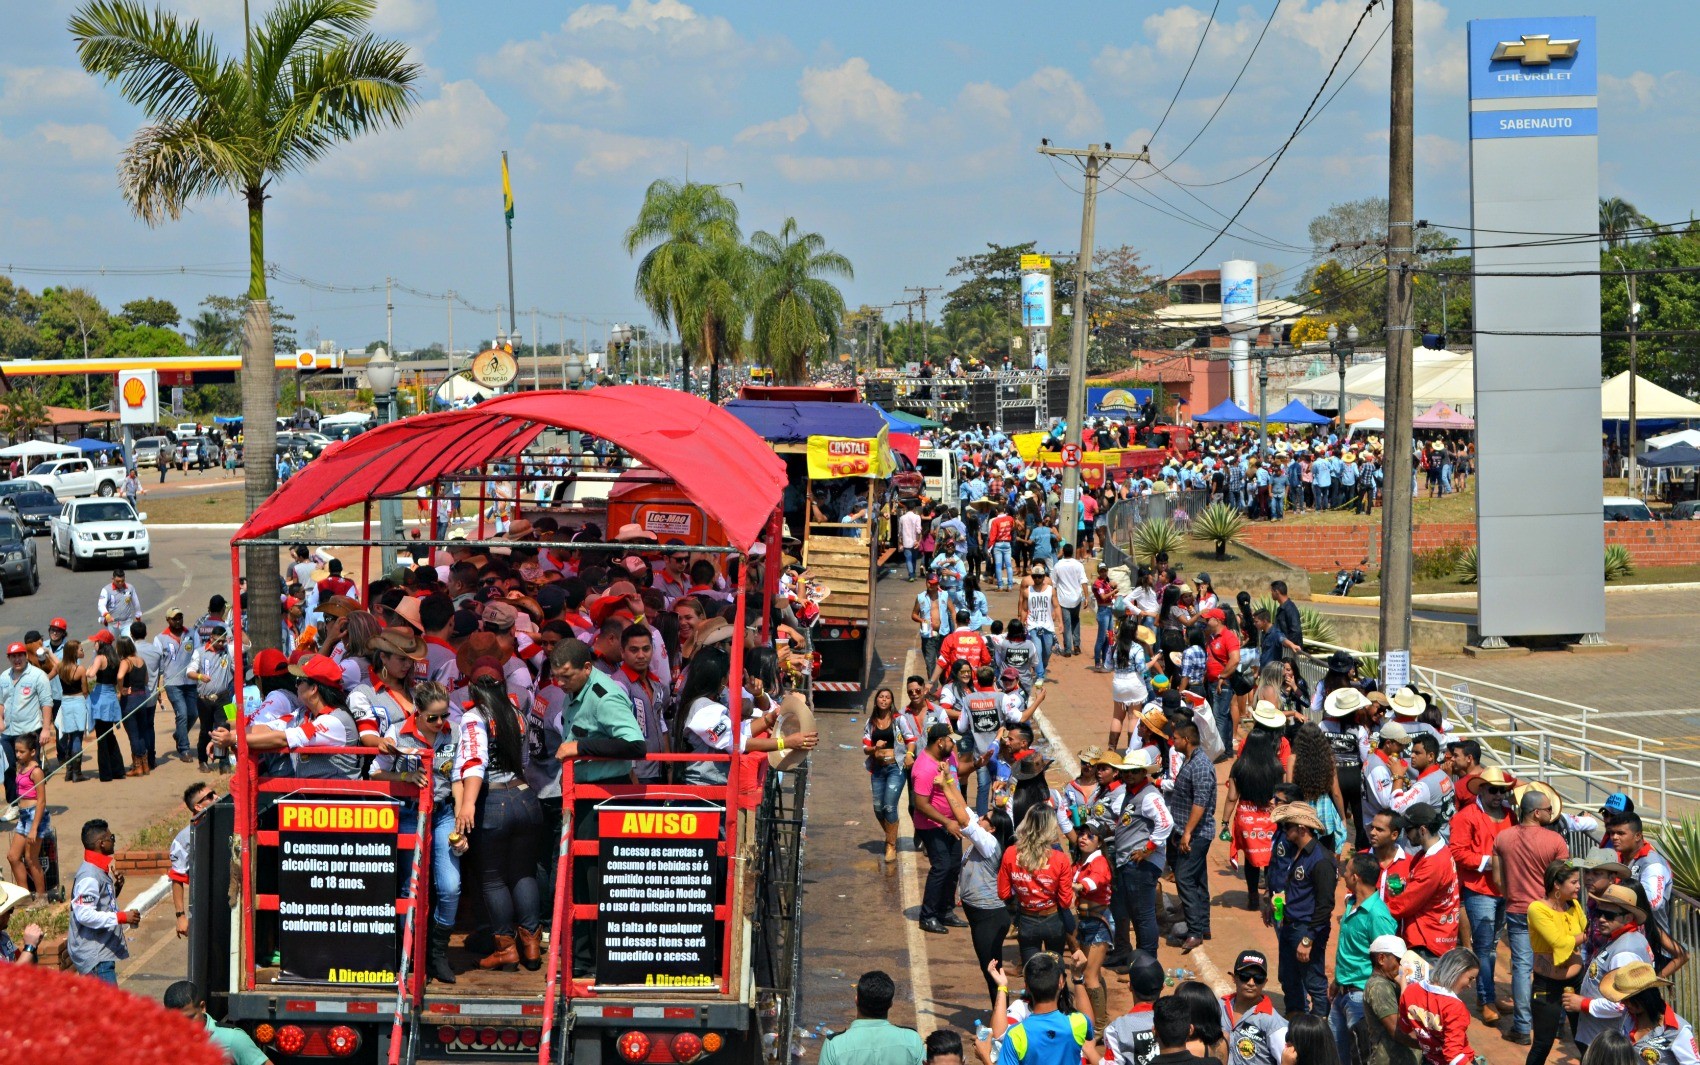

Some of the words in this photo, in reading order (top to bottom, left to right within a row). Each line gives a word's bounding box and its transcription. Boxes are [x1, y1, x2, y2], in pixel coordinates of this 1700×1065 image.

[1497, 72, 1573, 82] CHEVROLET
[1500, 117, 1573, 130] SABENAUTO
[829, 441, 867, 455] CRYSTAL
[1031, 596, 1049, 609] OMG
[283, 807, 394, 829] PROIBIDO
[622, 813, 697, 834] AVISO
[284, 842, 290, 853] O
[293, 844, 338, 855] consumo
[341, 843, 353, 855] de
[356, 843, 391, 856] bebida
[613, 847, 618, 857] O
[620, 848, 649, 857] acesso
[651, 849, 661, 857] as
[663, 848, 696, 857] carretas
[698, 849, 703, 857] e
[282, 859, 328, 871] alcoólica
[331, 862, 347, 873] por
[350, 862, 394, 873] menores
[607, 862, 645, 870] consumo
[646, 860, 656, 871] de
[658, 860, 690, 871] bebidas
[692, 860, 702, 871] só
[703, 860, 708, 871] é
[311, 876, 323, 888] de
[325, 877, 336, 888] 18
[338, 878, 365, 889] anos.
[603, 874, 643, 885] permitido
[645, 876, 662, 885] com
[664, 876, 669, 885] a
[670, 875, 699, 885] camisa
[701, 875, 711, 885] da
[610, 888, 645, 898] comitiva
[647, 888, 674, 901] Galpão
[676, 888, 706, 899] Modelo
[280, 902, 303, 915] Sobe
[306, 905, 329, 918] pena
[331, 904, 343, 916] de
[345, 904, 395, 918] apreensão
[600, 903, 605, 912] e
[606, 904, 611, 912] o
[613, 904, 628, 912] uso
[630, 902, 640, 912] da
[641, 902, 674, 913] pulseira
[676, 904, 686, 912] no
[688, 902, 713, 914] braço.
[283, 919, 328, 932] conforme
[330, 922, 336, 932] a
[338, 920, 351, 932] Lei
[353, 923, 368, 933] em
[369, 921, 395, 935] vigor.
[608, 922, 620, 933] Na
[621, 922, 643, 933] falta
[645, 923, 658, 933] de
[659, 923, 703, 935] qualquer
[606, 938, 621, 947] um
[623, 936, 656, 947] desses
[658, 936, 682, 947] itens
[684, 936, 706, 947] será
[608, 951, 653, 962] impedido
[655, 953, 661, 962] o
[663, 953, 700, 962] acesso.
[328, 969, 336, 982] A
[645, 974, 654, 986] A
